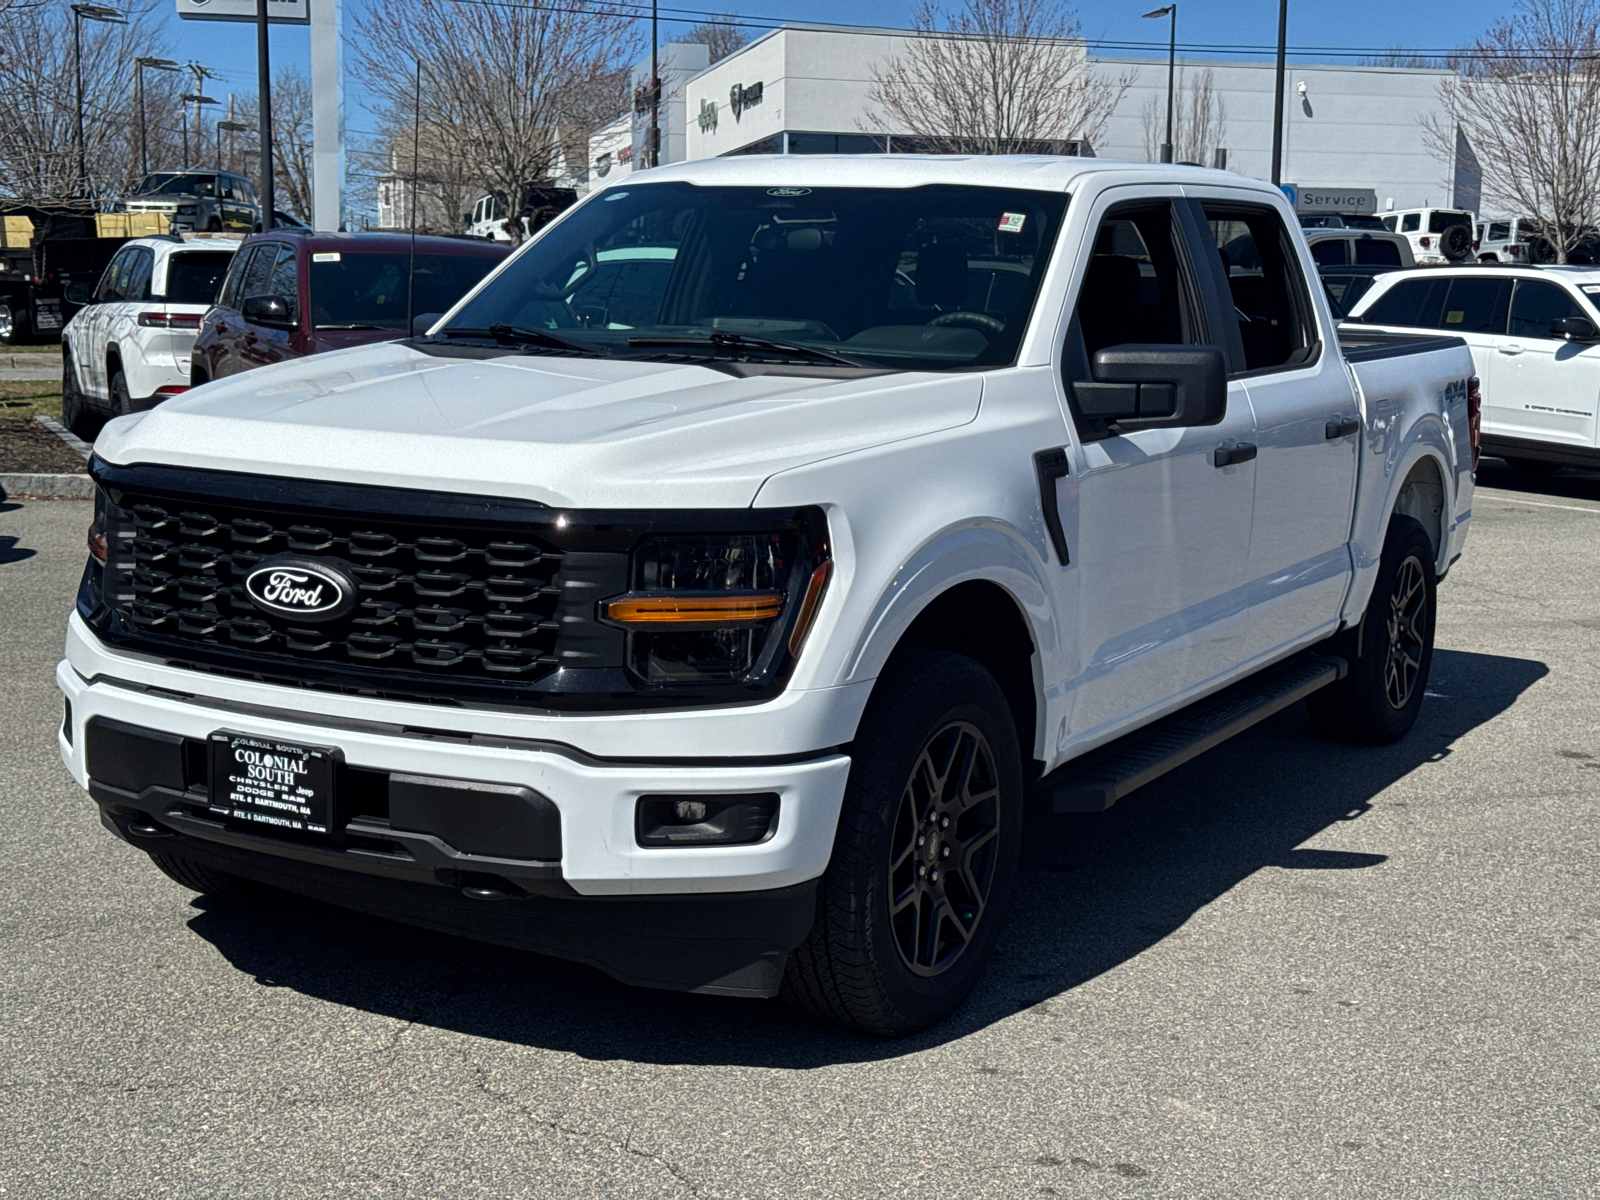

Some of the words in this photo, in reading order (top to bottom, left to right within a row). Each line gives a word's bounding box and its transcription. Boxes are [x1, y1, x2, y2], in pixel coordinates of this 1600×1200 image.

[1304, 193, 1366, 206] Service
[264, 571, 323, 607] Ford
[276, 744, 304, 755] SOUTH
[234, 748, 308, 774] COLONIAL
[247, 764, 295, 786] SOUTH
[228, 775, 289, 792] CHRYSLER
[295, 786, 314, 798] Jeep
[236, 785, 275, 798] DODGE
[281, 795, 306, 803] RAM
[230, 793, 246, 803] RTE.
[247, 795, 252, 803] 6
[254, 797, 299, 813] DARTMOUTH,
[300, 806, 311, 815] MA
[233, 810, 247, 820] RTE.
[253, 813, 292, 829] DARTMOUTH,
[292, 821, 302, 829] MA
[307, 825, 326, 833] RAM
